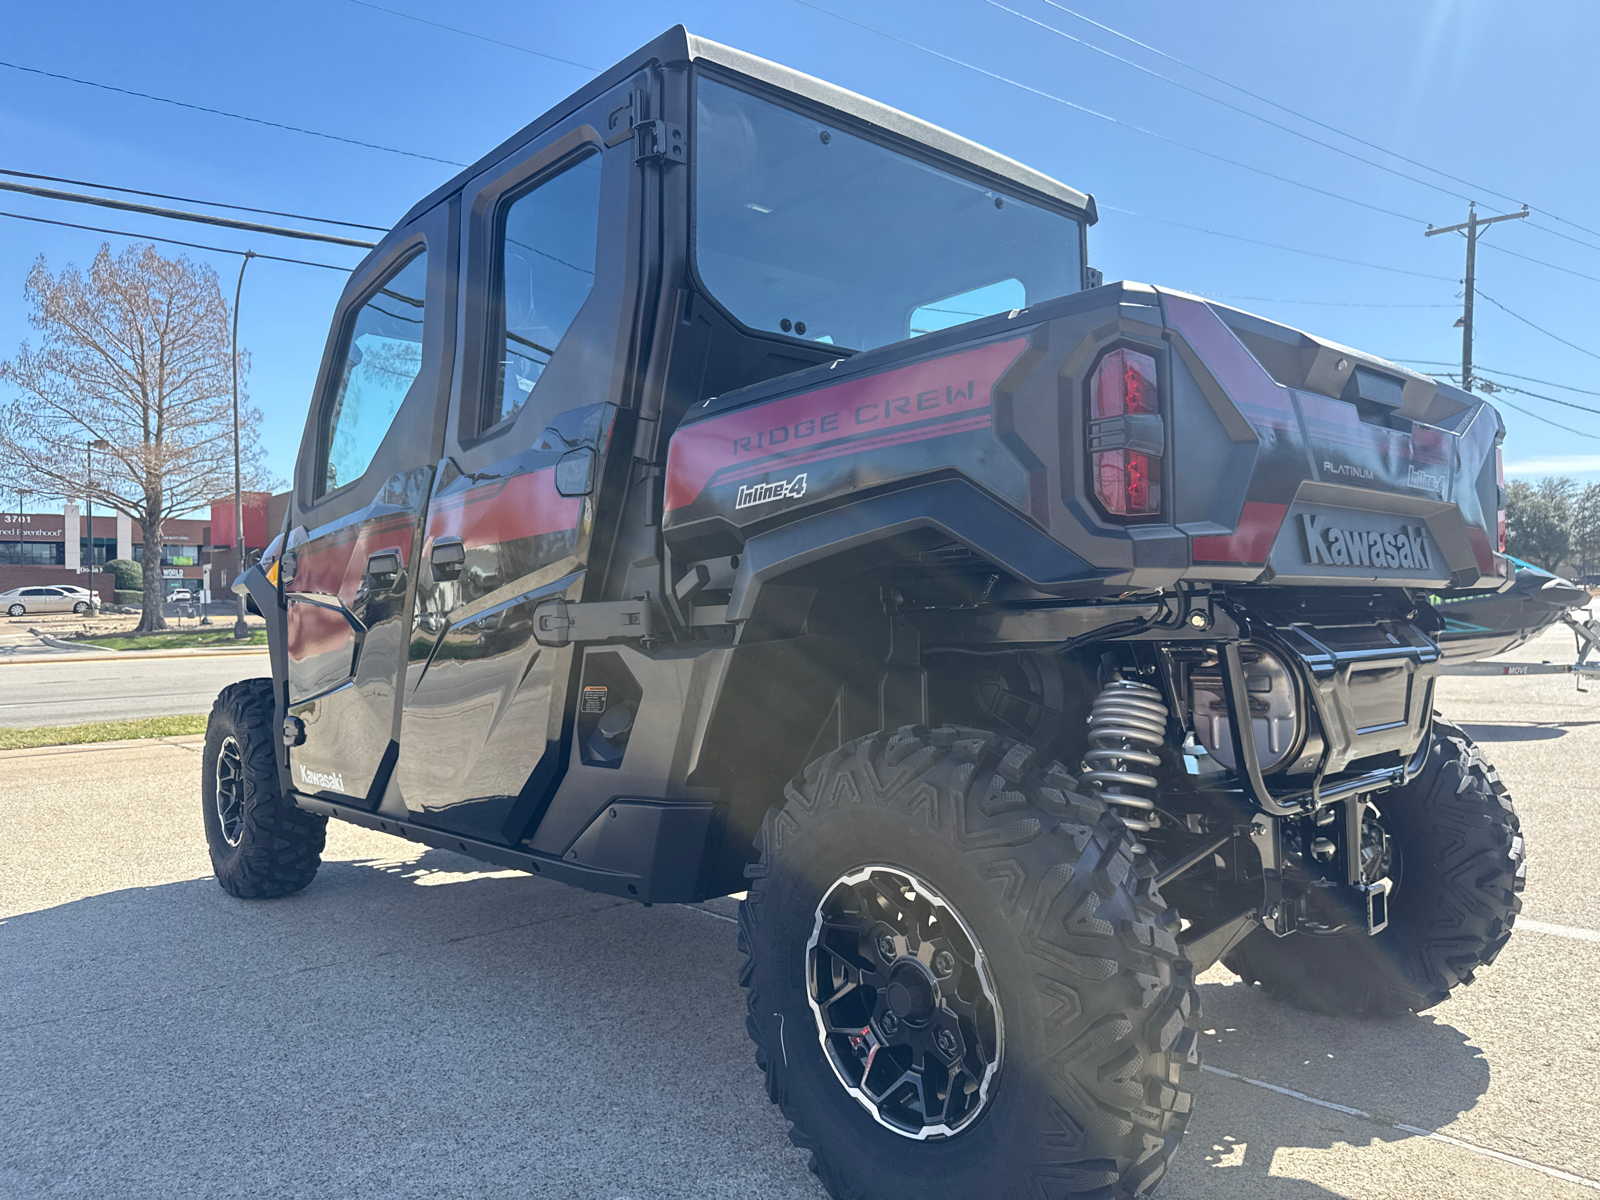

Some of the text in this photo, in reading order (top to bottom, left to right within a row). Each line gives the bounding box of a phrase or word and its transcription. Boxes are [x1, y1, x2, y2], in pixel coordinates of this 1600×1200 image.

[733, 380, 975, 456] RIDGE CREW
[1323, 461, 1374, 480] PLATINUM
[4, 515, 31, 524] 3701
[1298, 513, 1434, 570] Kawasaki
[1508, 666, 1529, 675] MOVE
[299, 764, 345, 793] Kawasaki
